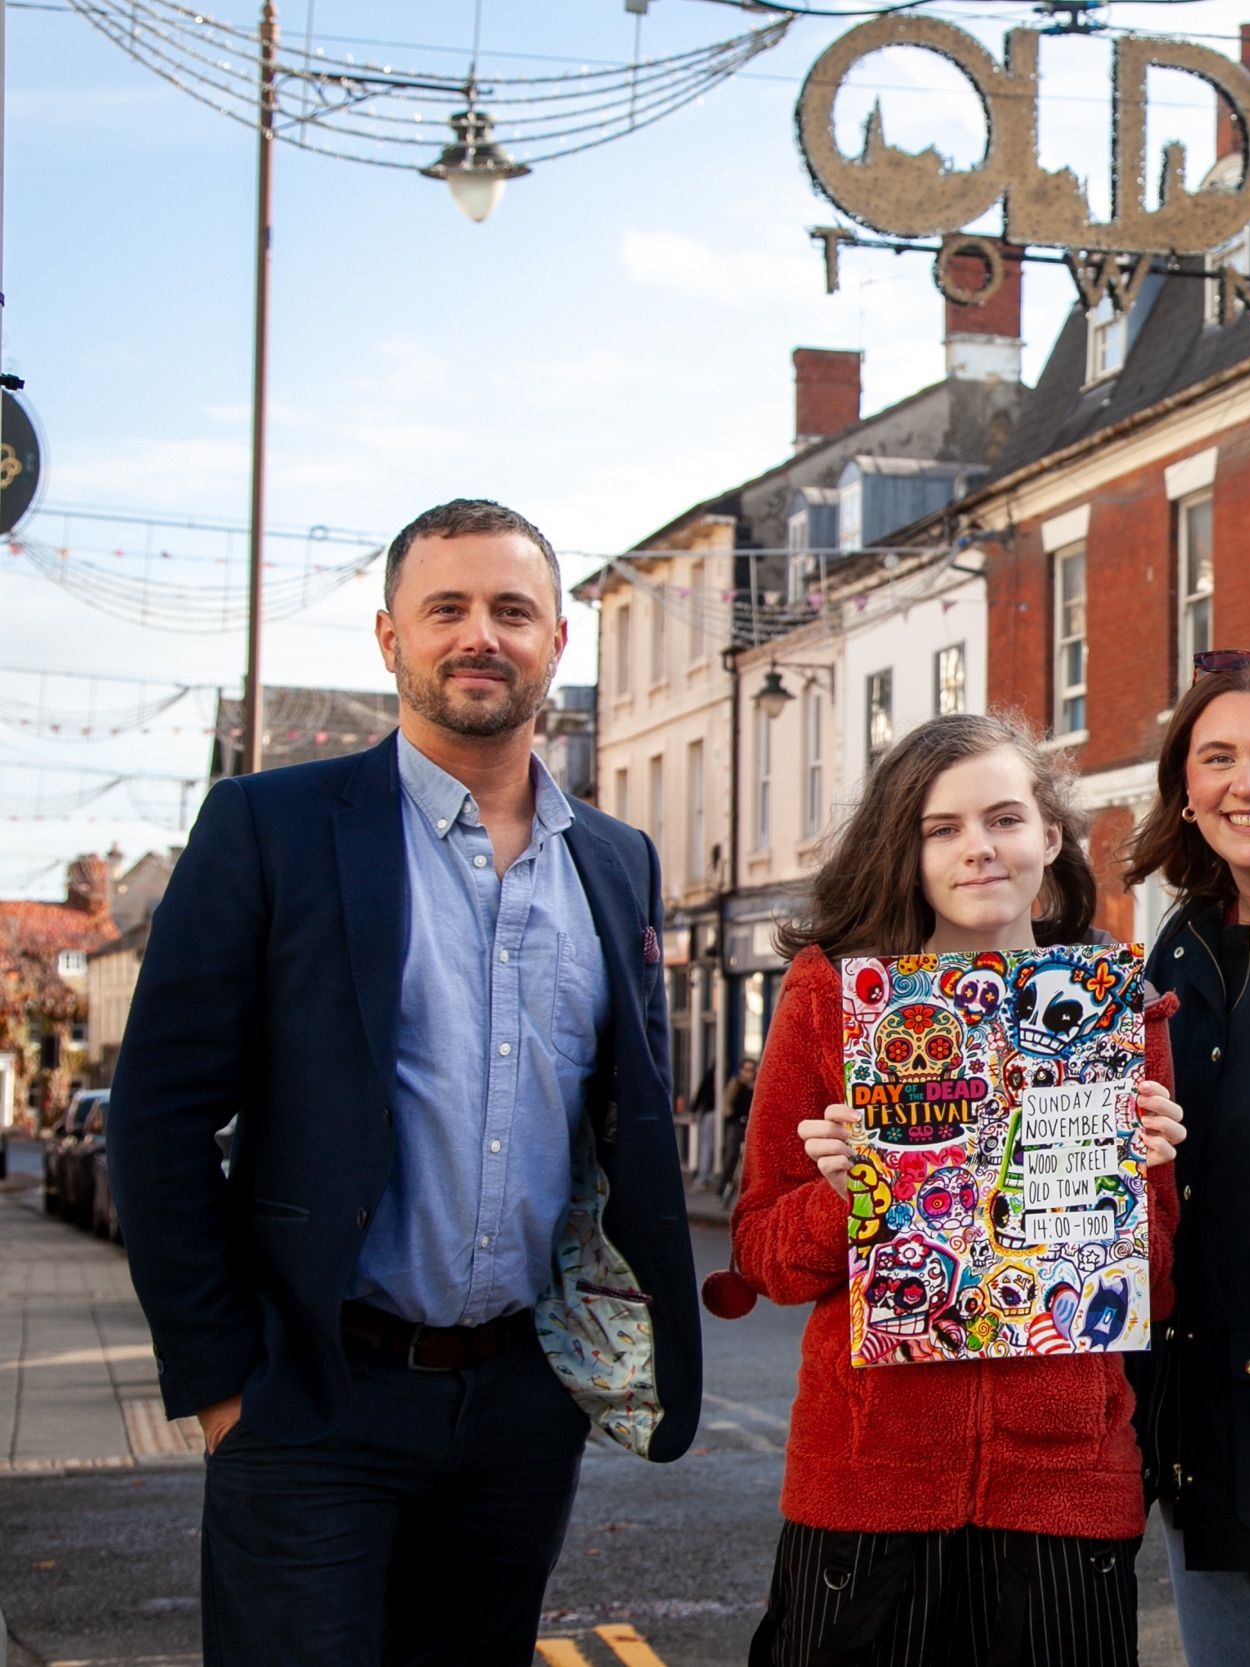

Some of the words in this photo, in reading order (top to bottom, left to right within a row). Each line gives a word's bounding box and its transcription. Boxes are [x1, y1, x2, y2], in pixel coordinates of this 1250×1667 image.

[855, 1084, 904, 1105] DAY
[904, 1085, 918, 1093] OF
[909, 1093, 924, 1101] THE
[925, 1079, 986, 1101] DEAD
[866, 1099, 975, 1128] FESTIVAL
[1027, 1090, 1092, 1117] SUNDAY
[908, 1125, 933, 1138] OLD
[1026, 1113, 1113, 1139] NOVEMBER
[1028, 1153, 1058, 1175] WOOD
[1065, 1149, 1107, 1174] STREET
[1029, 1181, 1049, 1204] OLD
[1056, 1179, 1089, 1199] TOWN
